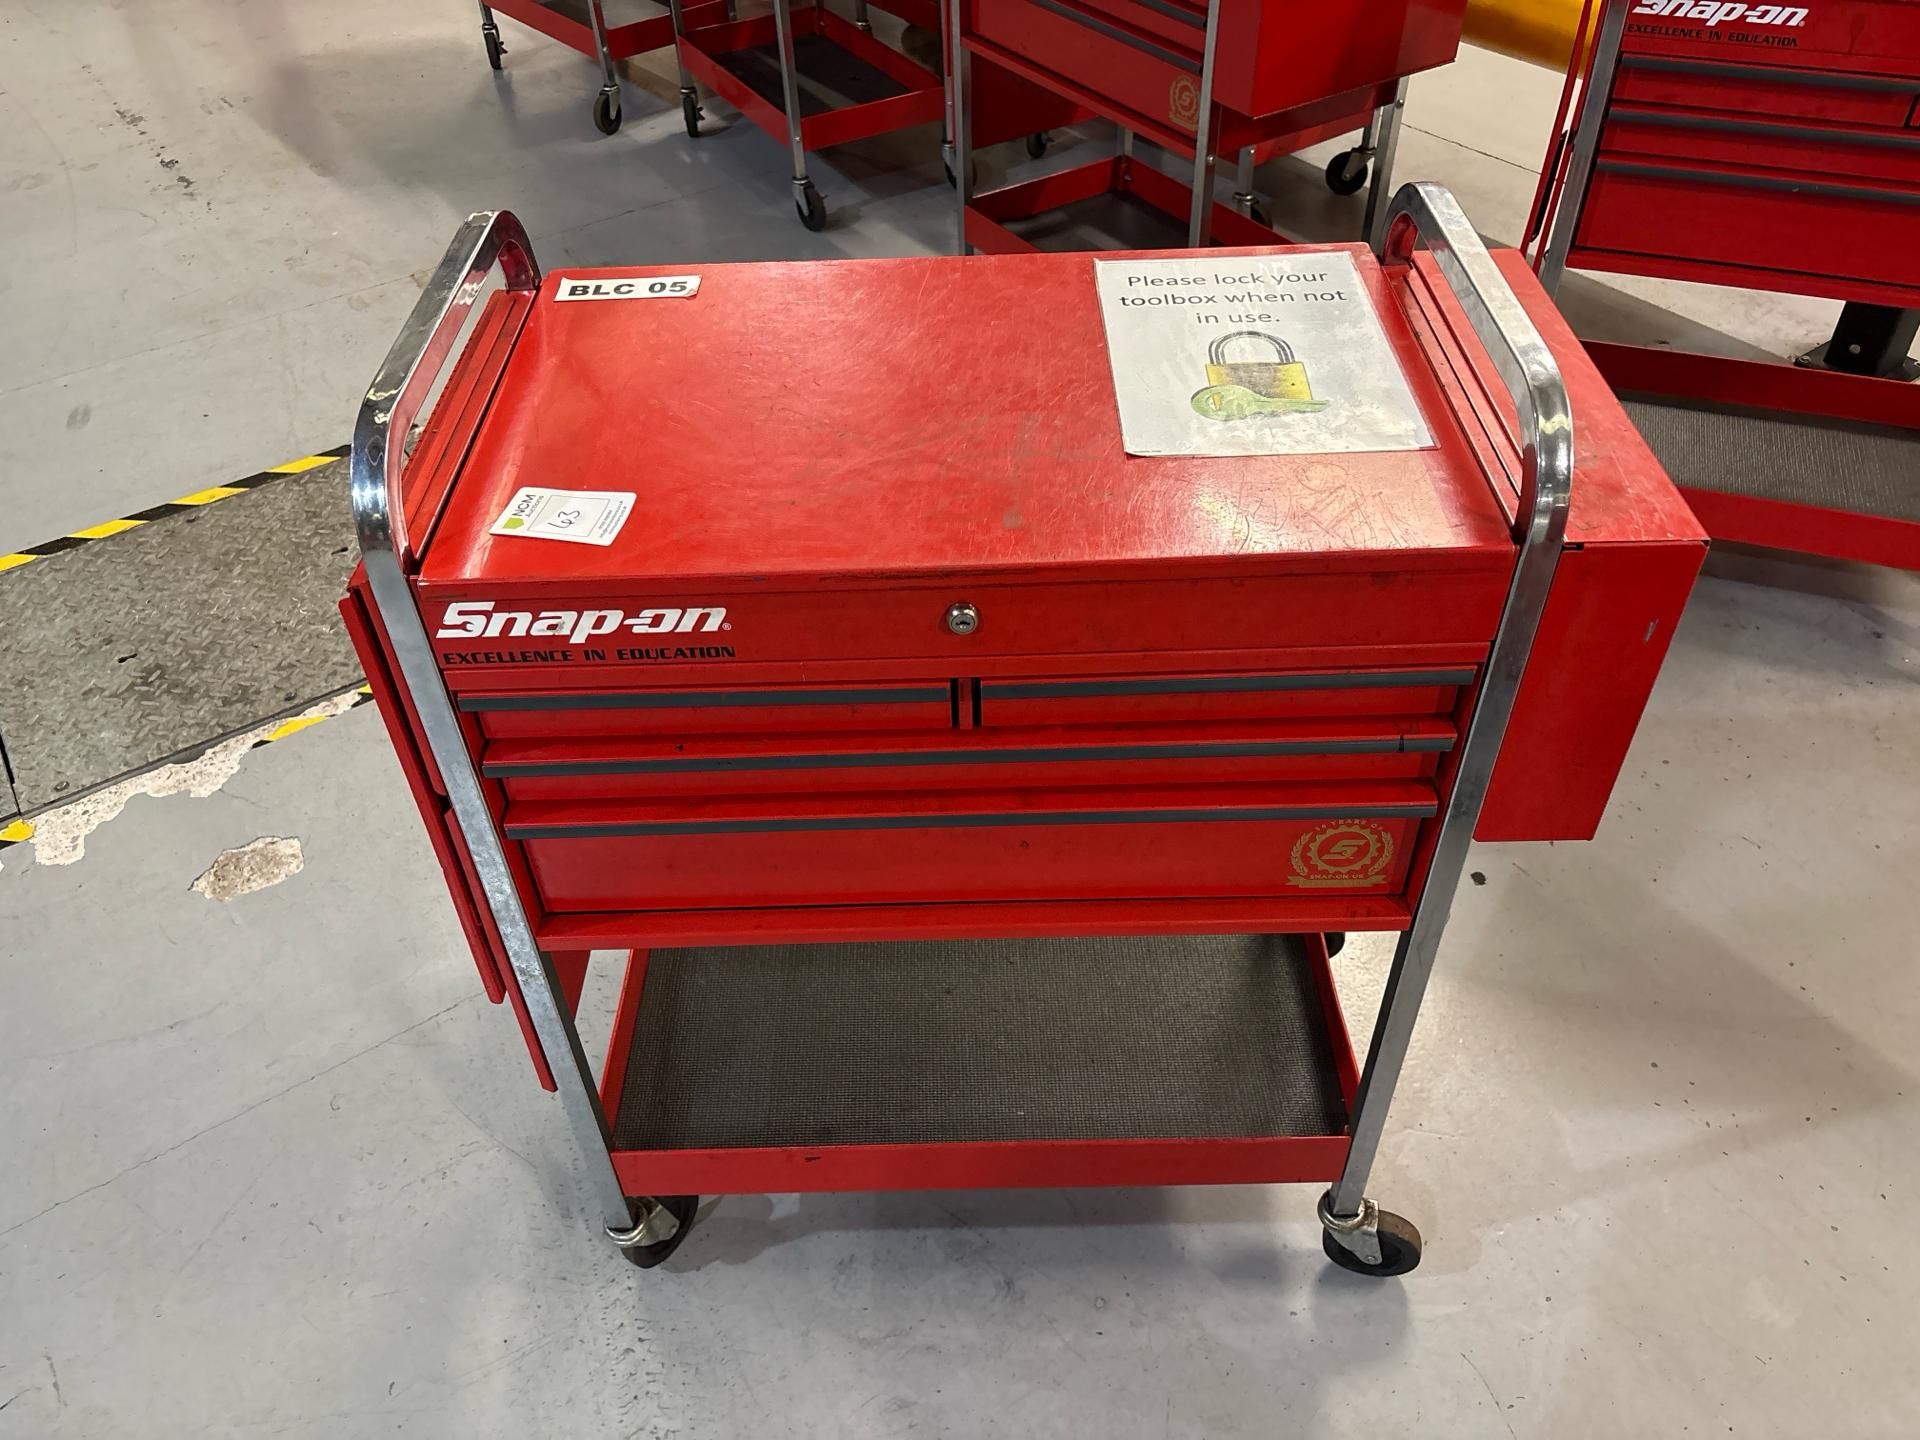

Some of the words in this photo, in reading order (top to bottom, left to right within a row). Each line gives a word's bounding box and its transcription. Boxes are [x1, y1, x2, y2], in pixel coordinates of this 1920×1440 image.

[1627, 23, 1703, 38] EXCELLENCE
[1708, 30, 1722, 41] IN
[1728, 33, 1798, 47] EDUCATION
[1128, 275, 1206, 287] Please
[1215, 272, 1265, 285] lock
[1268, 270, 1328, 286] your
[568, 283, 635, 296] BLC
[648, 281, 688, 293] 05
[1120, 293, 1217, 306] toolbox
[1223, 291, 1295, 304] when
[1303, 289, 1347, 301] not
[1196, 311, 1218, 324] in
[1228, 310, 1280, 323] use.
[512, 494, 536, 517] NCM
[444, 651, 574, 665] EXCELLENCE
[584, 649, 606, 661] IN
[617, 646, 736, 662] EDUCATION
